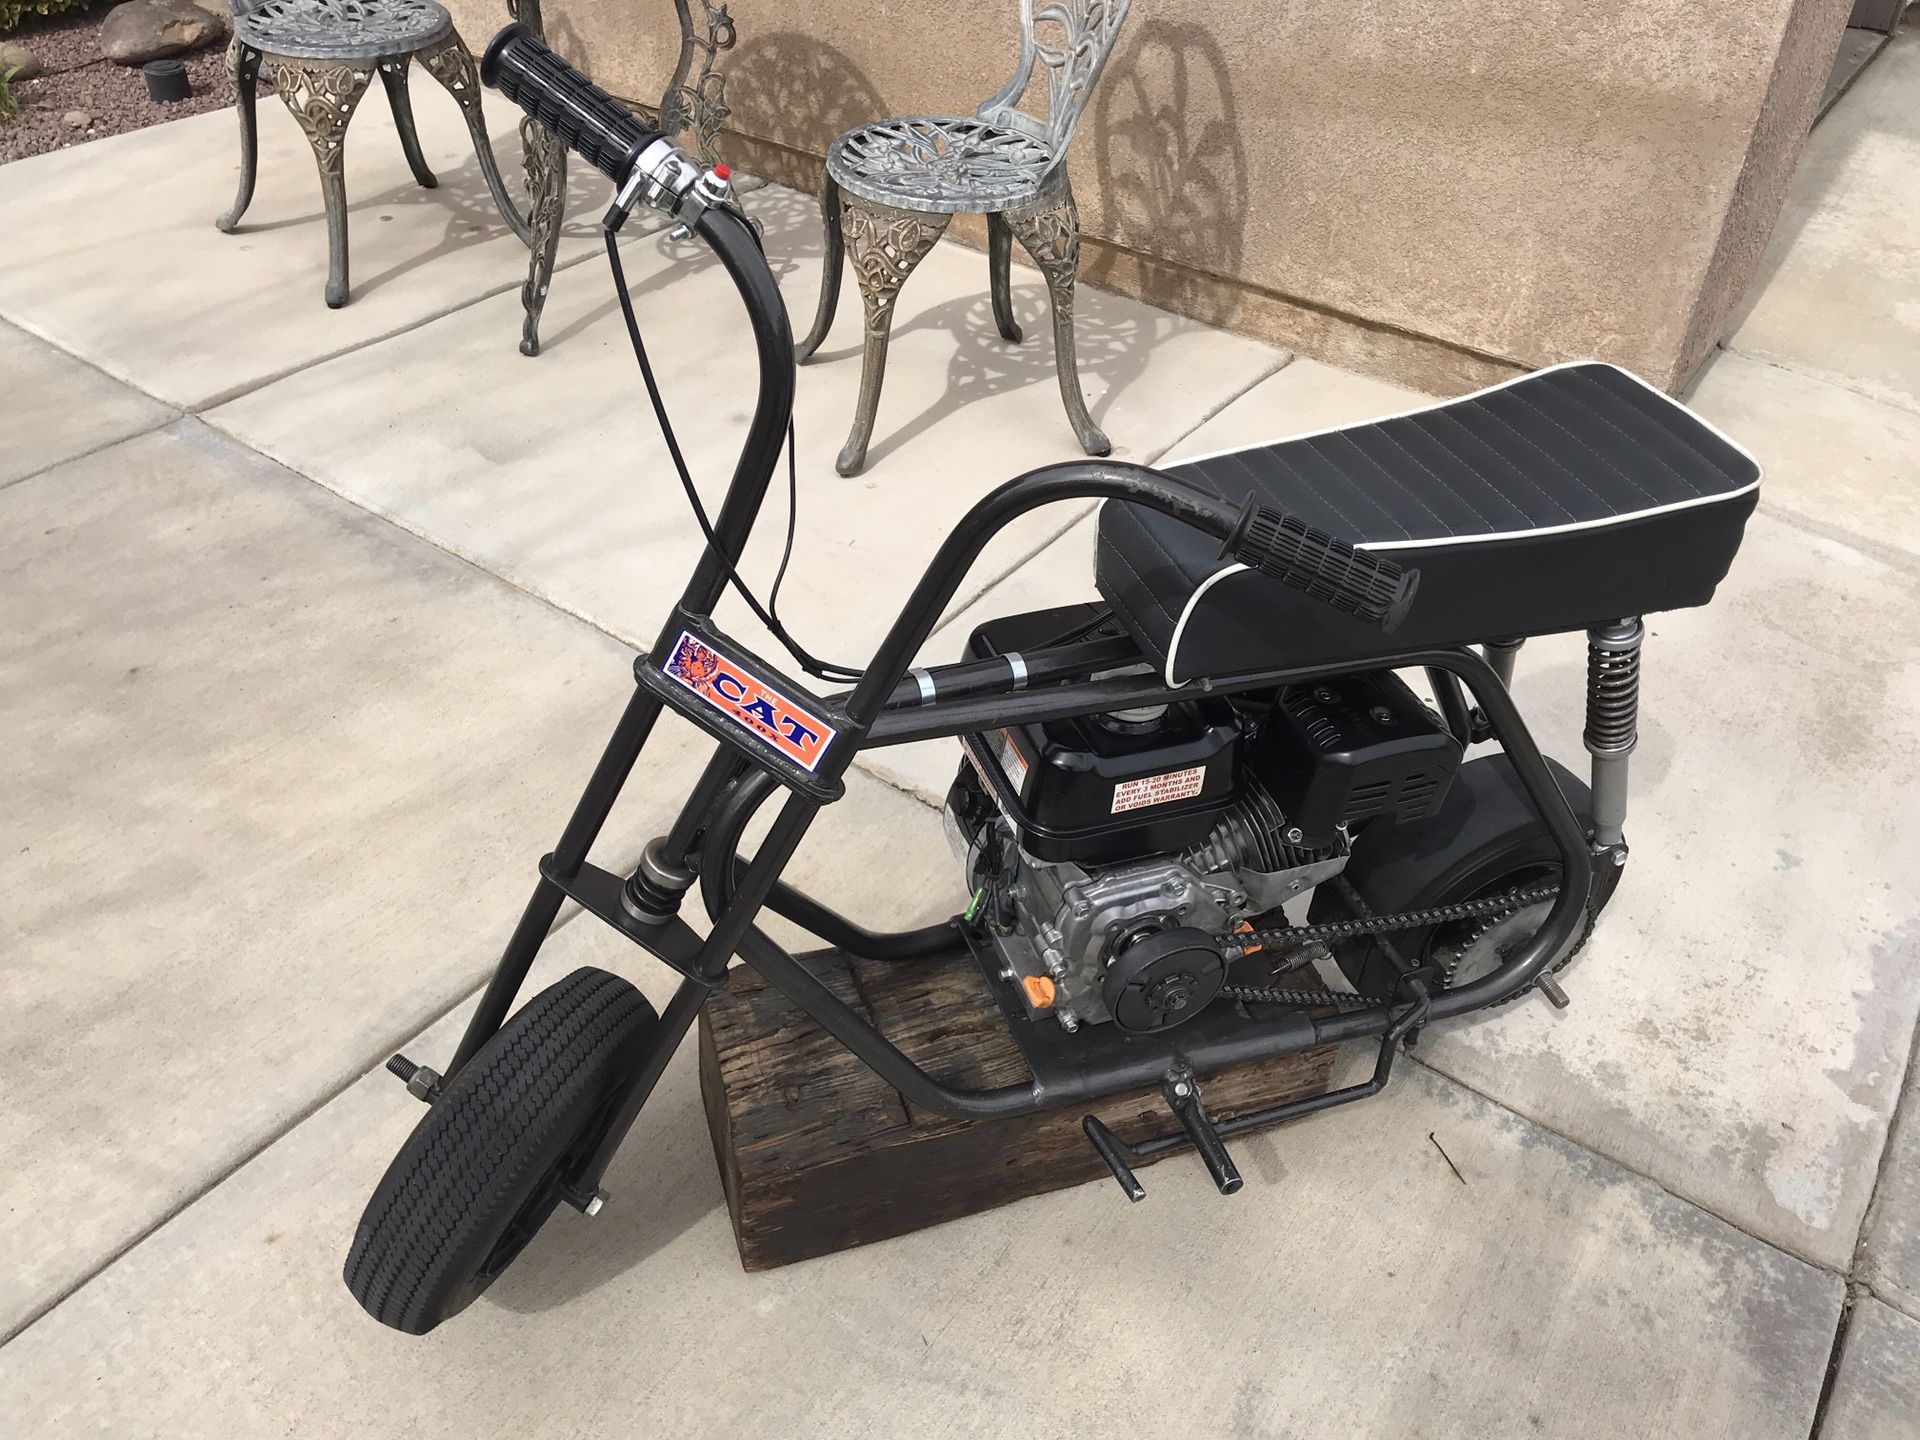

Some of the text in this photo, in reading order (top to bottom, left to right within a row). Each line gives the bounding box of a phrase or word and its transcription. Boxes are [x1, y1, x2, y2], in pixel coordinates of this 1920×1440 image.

[760, 689, 777, 706] THE
[711, 671, 819, 750] CAT
[1115, 787, 1141, 798] EVERY
[1150, 779, 1183, 790] MONTHS
[1184, 775, 1201, 784] AND
[1122, 768, 1198, 790] RUN 15-20 MINUTES
[1115, 782, 1199, 805] ADD FUEL STABILIZER
[1128, 800, 1151, 809] VOIDS
